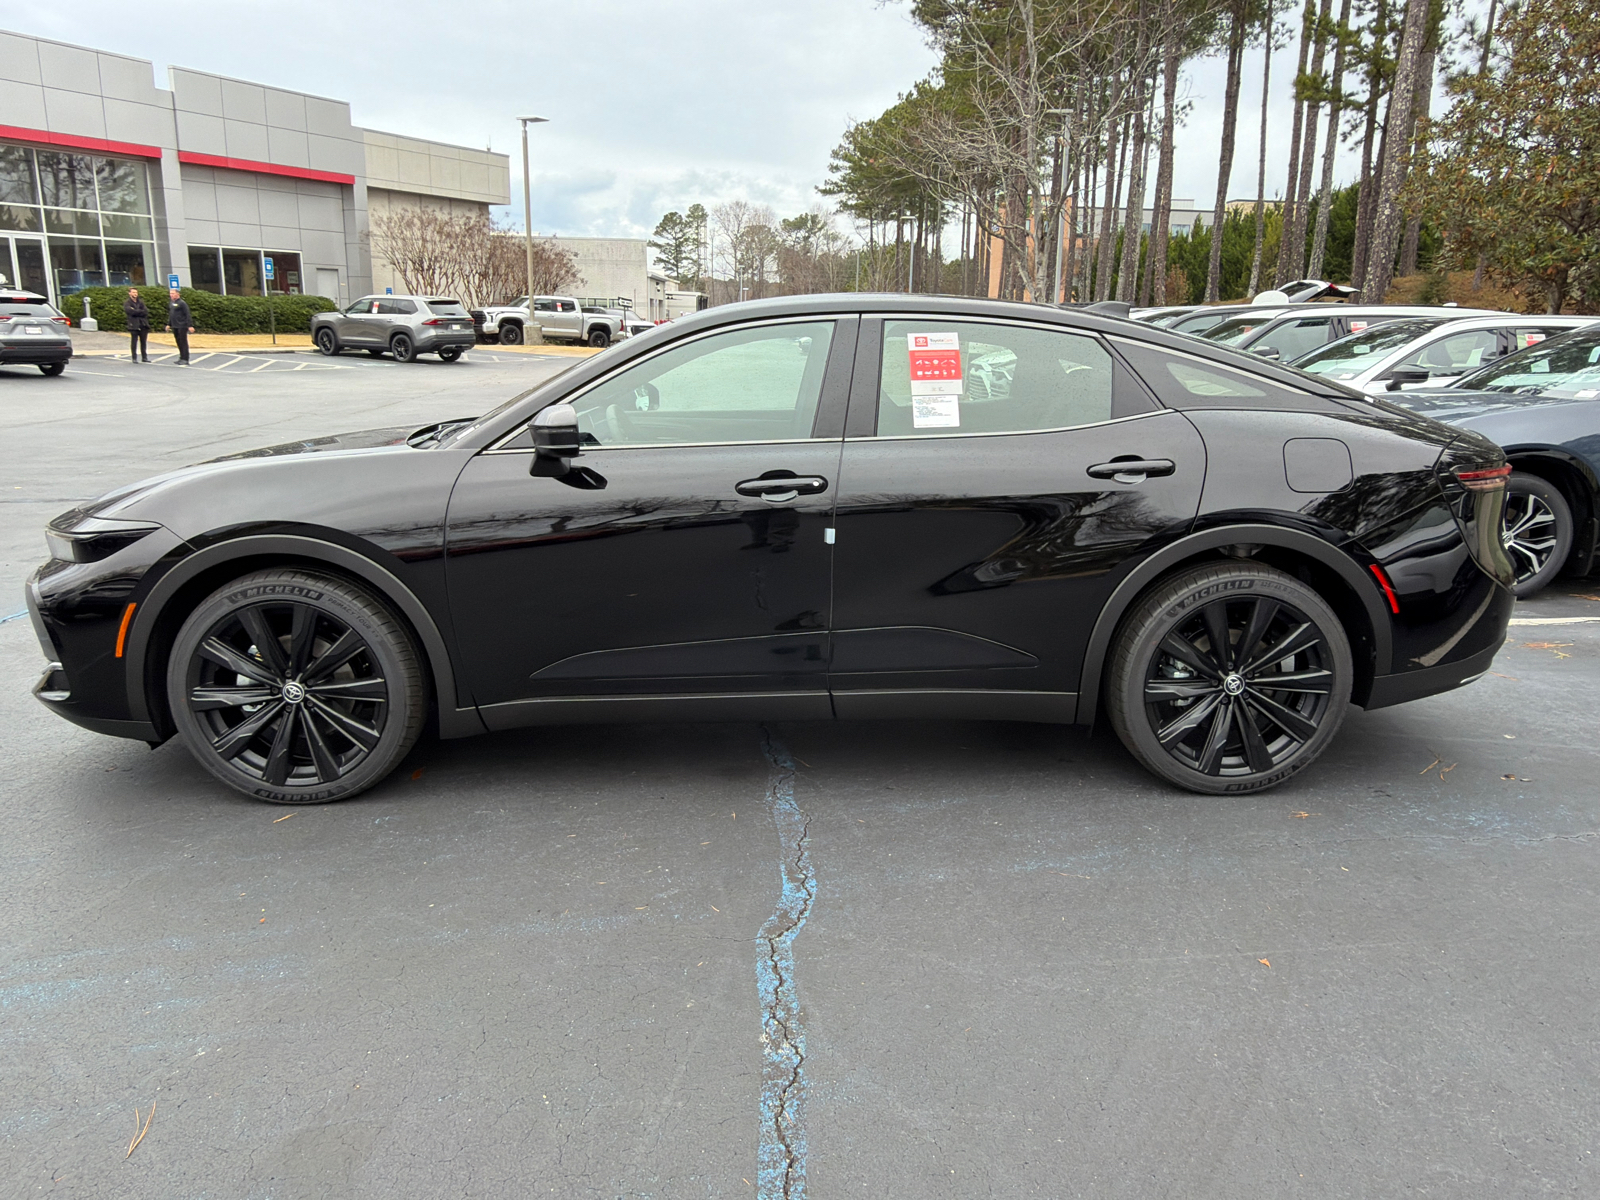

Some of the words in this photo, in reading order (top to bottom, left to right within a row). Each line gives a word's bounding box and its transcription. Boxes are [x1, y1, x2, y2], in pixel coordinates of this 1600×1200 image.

[247, 586, 320, 598] MICHELIN
[1184, 581, 1251, 607] MICHELIN
[259, 790, 328, 801] MICHELIN
